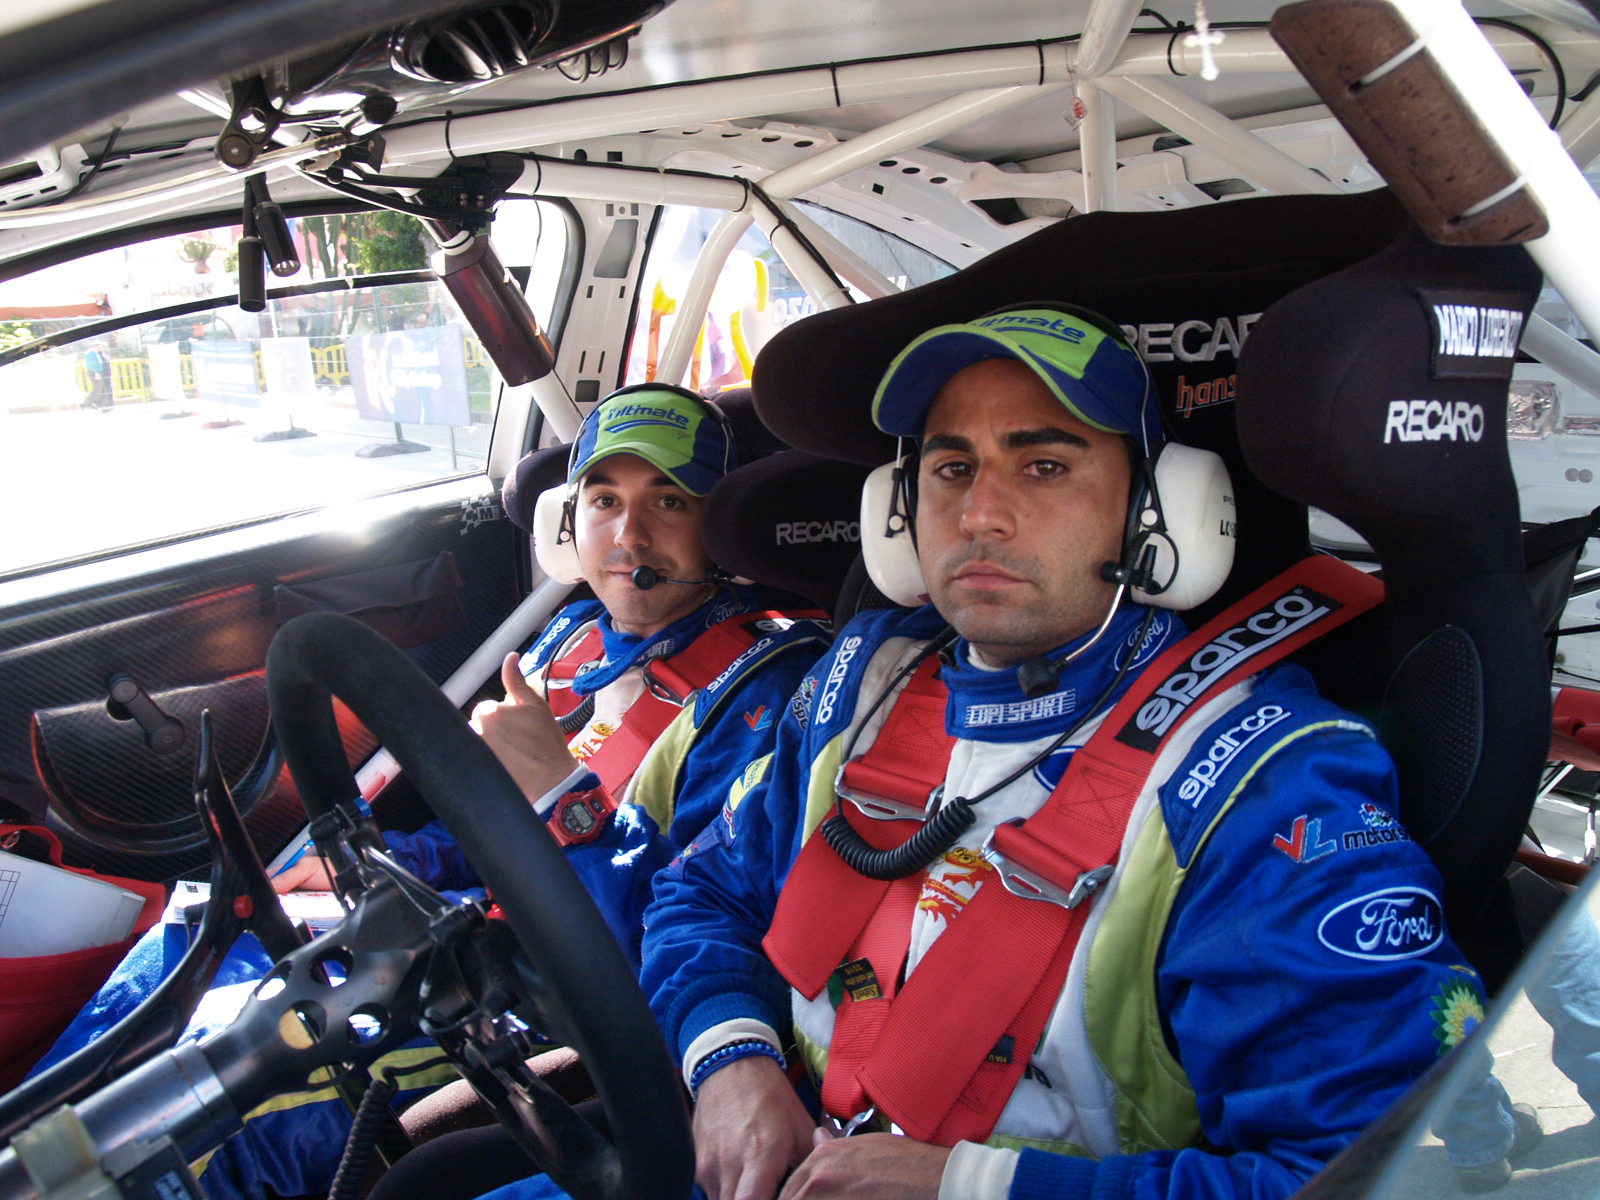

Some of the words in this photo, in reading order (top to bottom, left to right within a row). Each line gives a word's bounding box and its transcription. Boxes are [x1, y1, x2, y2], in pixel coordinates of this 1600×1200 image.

[607, 404, 690, 427] ultimate
[1383, 400, 1485, 444] RECARO
[775, 520, 861, 546] RECARO
[706, 637, 774, 694] sparco
[815, 635, 862, 725] sparco
[1136, 590, 1326, 737] sparco
[1178, 704, 1291, 808] sparco
[1355, 895, 1436, 952] Ford
